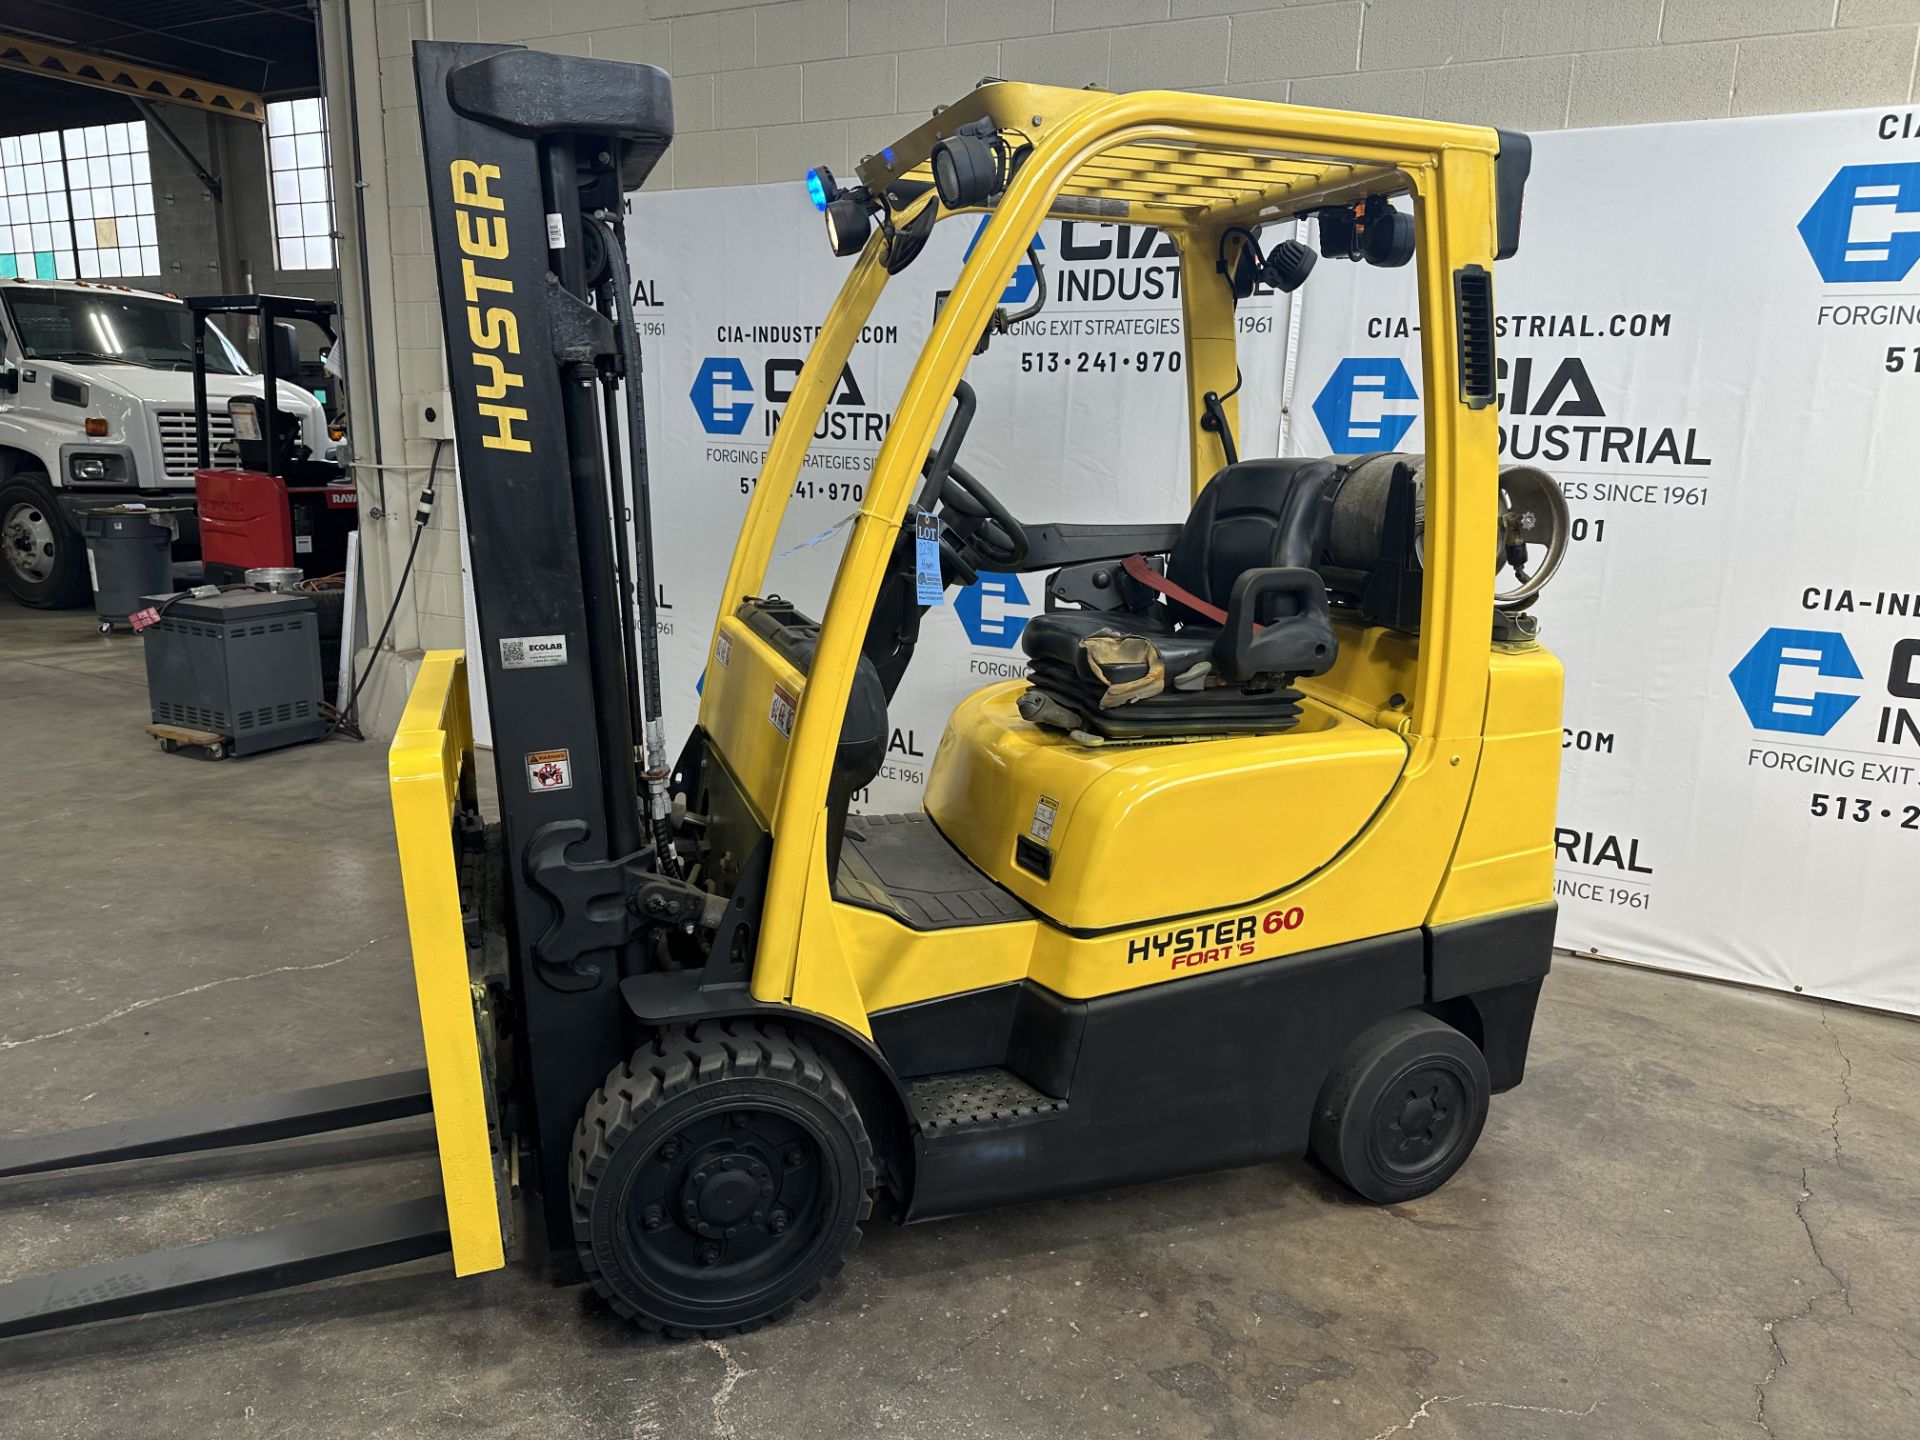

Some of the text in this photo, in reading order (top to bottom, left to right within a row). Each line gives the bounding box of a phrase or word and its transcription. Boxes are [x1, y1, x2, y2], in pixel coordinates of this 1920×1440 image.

[450, 159, 532, 453] HYSTER
[1817, 304, 1920, 326] FORGIN
[644, 322, 665, 336] 1961
[1050, 319, 1087, 335] EXIT
[1086, 318, 1180, 335] STRATEGIES
[1238, 316, 1273, 334] 1961
[706, 448, 758, 464] FORGING
[1593, 484, 1658, 503] SINCE
[1663, 486, 1708, 506] 1961
[918, 526, 937, 540] LOT
[528, 642, 563, 652] ECOLAB
[898, 768, 924, 785] 1961
[1748, 748, 1915, 786] FORGING EXIT
[1553, 878, 1651, 911] INCE 1961
[1127, 906, 1306, 965] HYSTER 60
